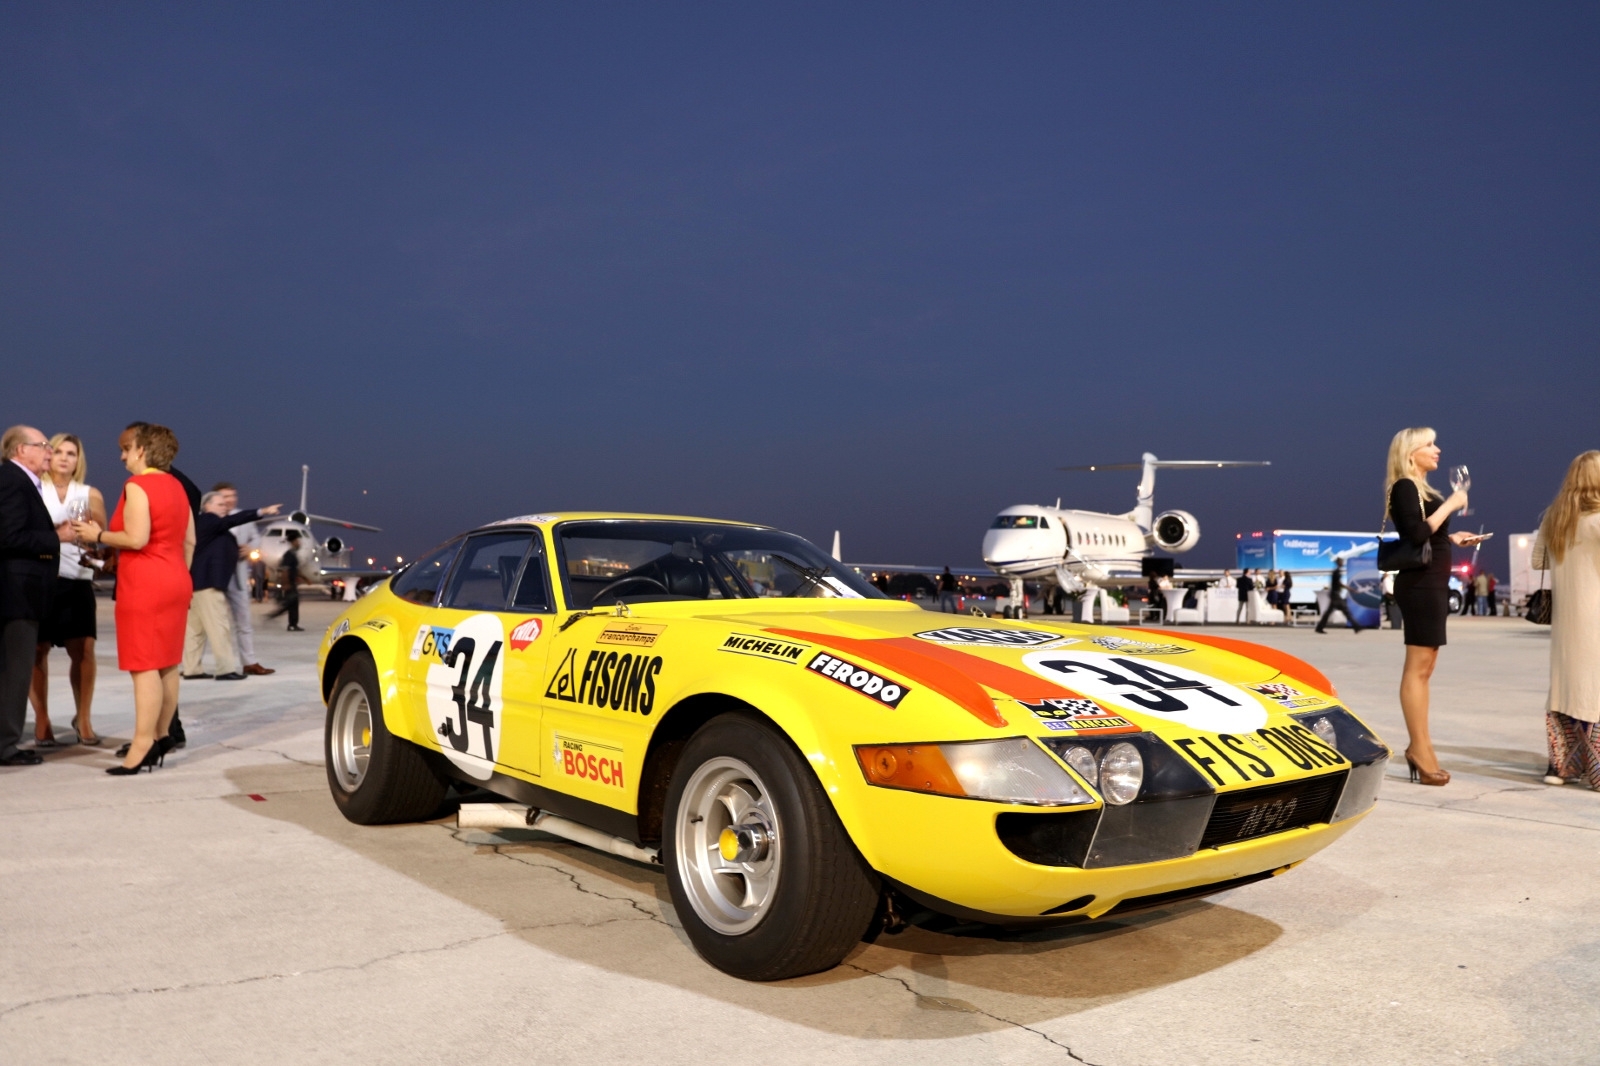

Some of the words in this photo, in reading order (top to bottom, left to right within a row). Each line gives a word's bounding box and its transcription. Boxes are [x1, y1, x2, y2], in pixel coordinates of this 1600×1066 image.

[422, 630, 452, 659] GTS
[724, 636, 804, 659] MICHELIN
[446, 636, 503, 763] 34
[578, 650, 663, 716] FISONS
[809, 654, 901, 702] FERODO
[1039, 657, 1243, 713] 34
[563, 741, 583, 752] RACING
[563, 749, 624, 788] BOSCH
